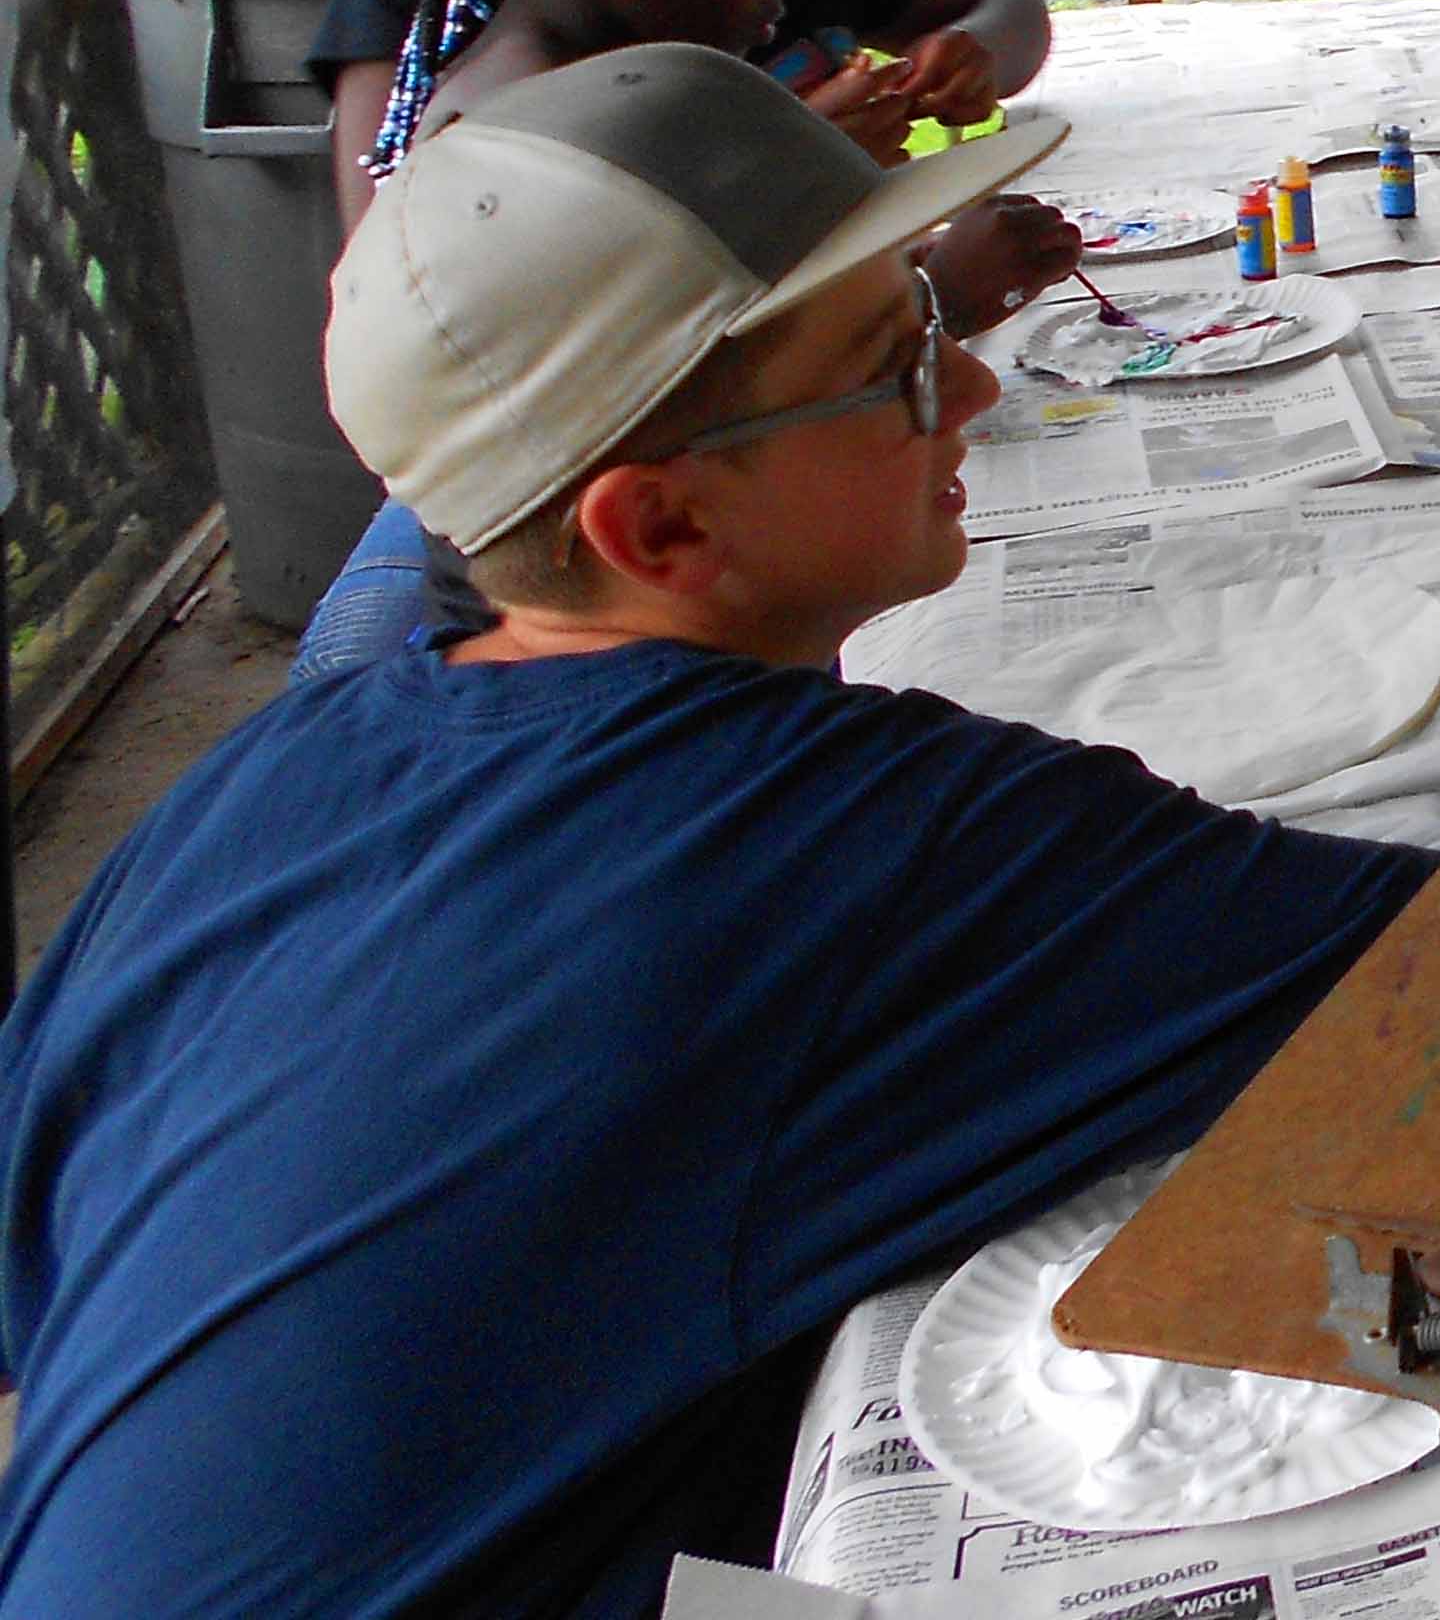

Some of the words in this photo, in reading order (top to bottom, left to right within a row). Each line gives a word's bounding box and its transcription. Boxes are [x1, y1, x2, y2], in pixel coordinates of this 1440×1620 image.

[1300, 503, 1385, 519] Williams
[1059, 1559, 1219, 1612] SCOREBOARD
[1173, 1585, 1258, 1619] WATCH
